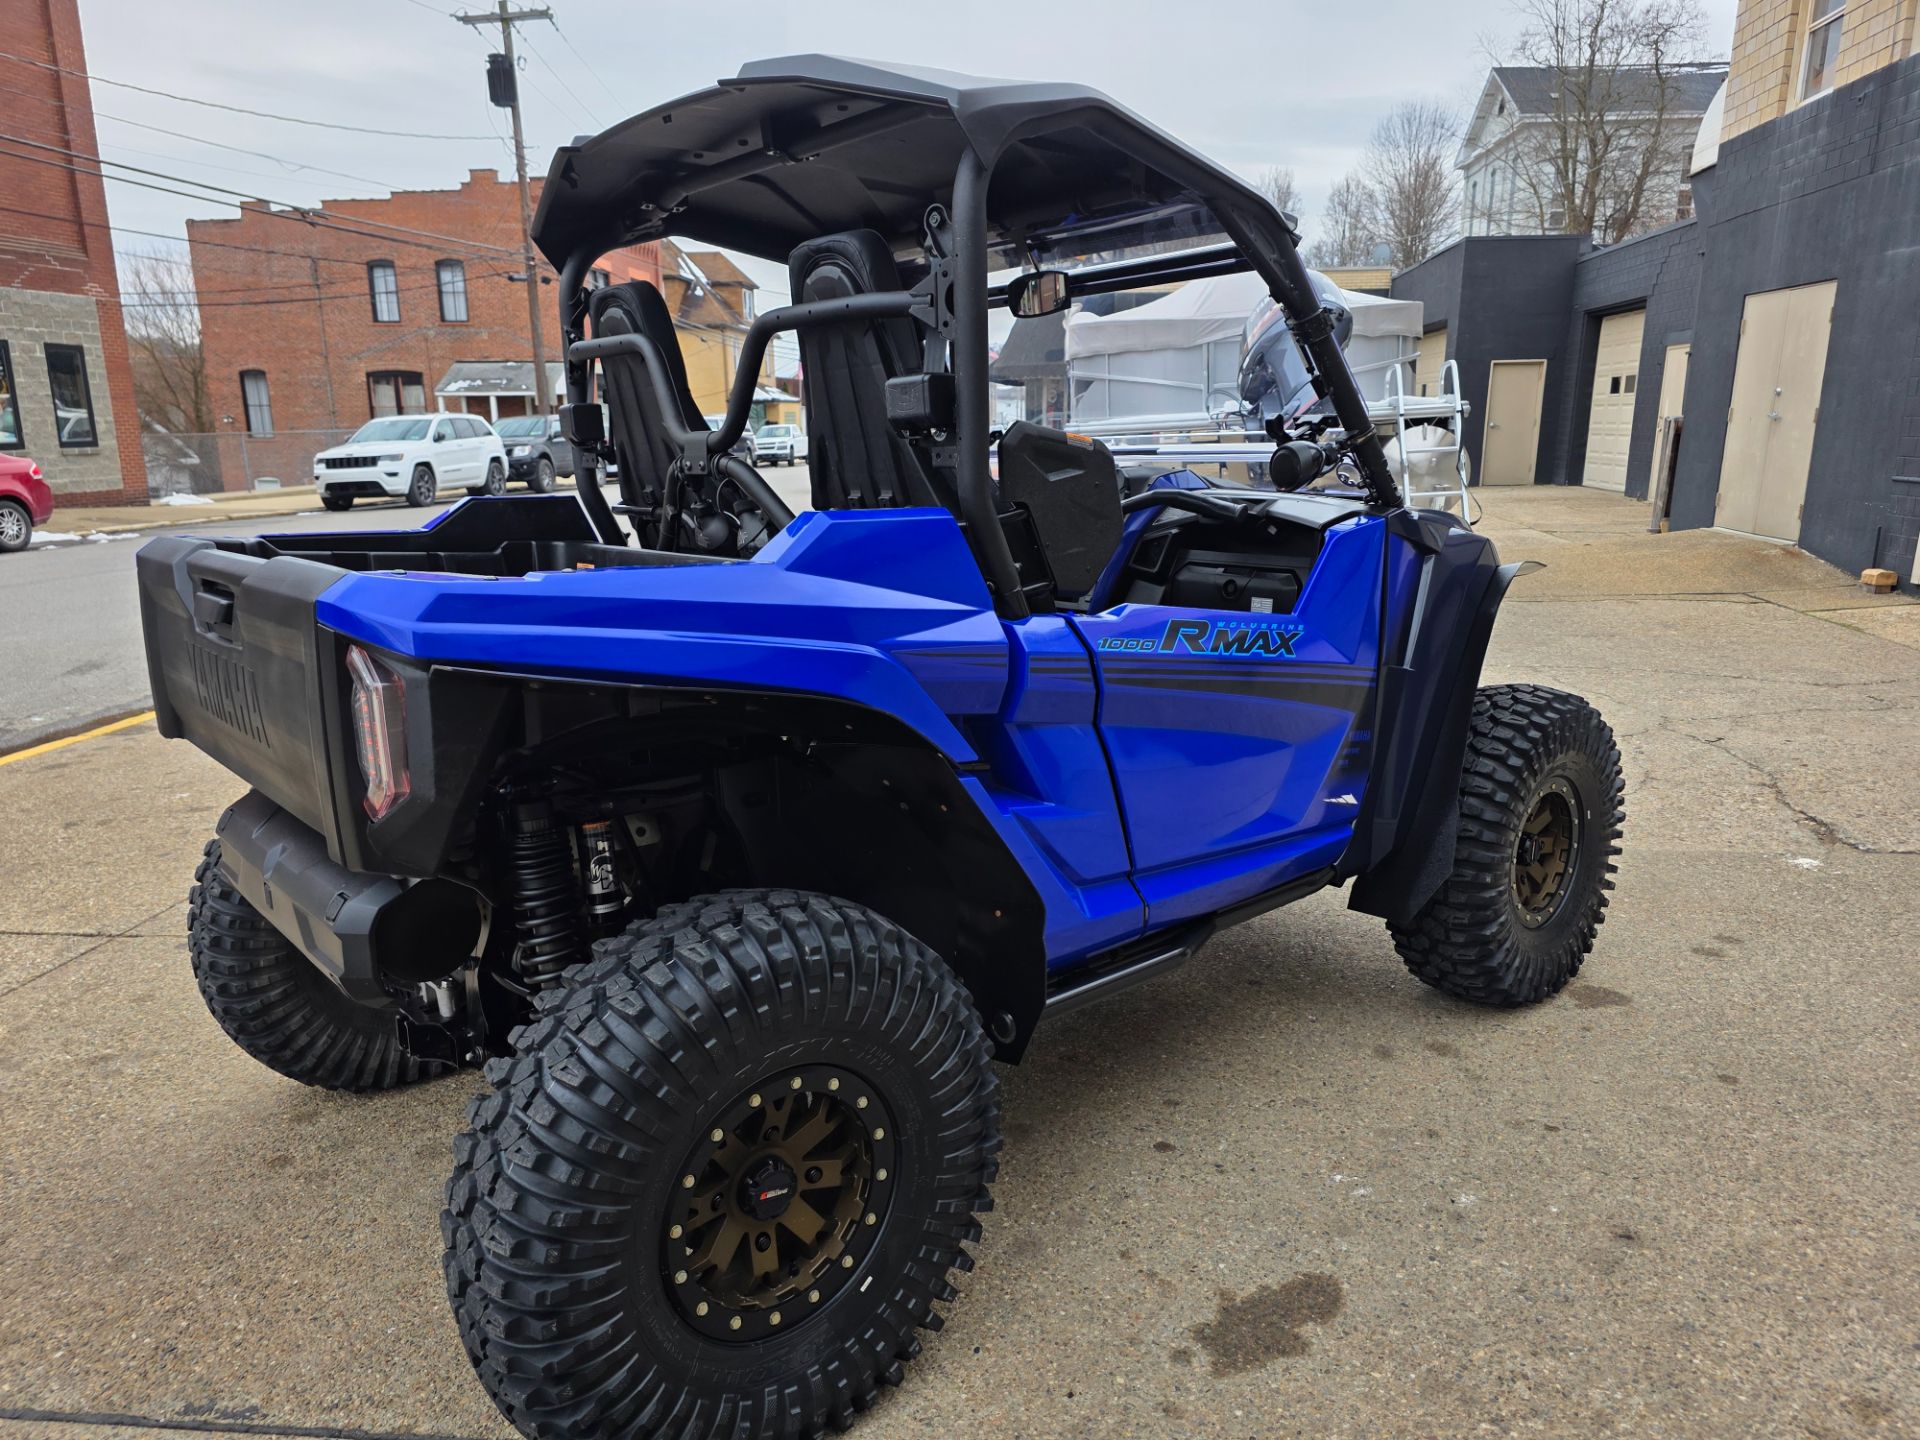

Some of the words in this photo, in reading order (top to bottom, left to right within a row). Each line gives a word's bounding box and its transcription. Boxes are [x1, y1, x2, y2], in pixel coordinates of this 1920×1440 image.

[1098, 637, 1157, 652] 1000
[1158, 618, 1304, 657] RMAX
[184, 635, 271, 749] YAMAHA
